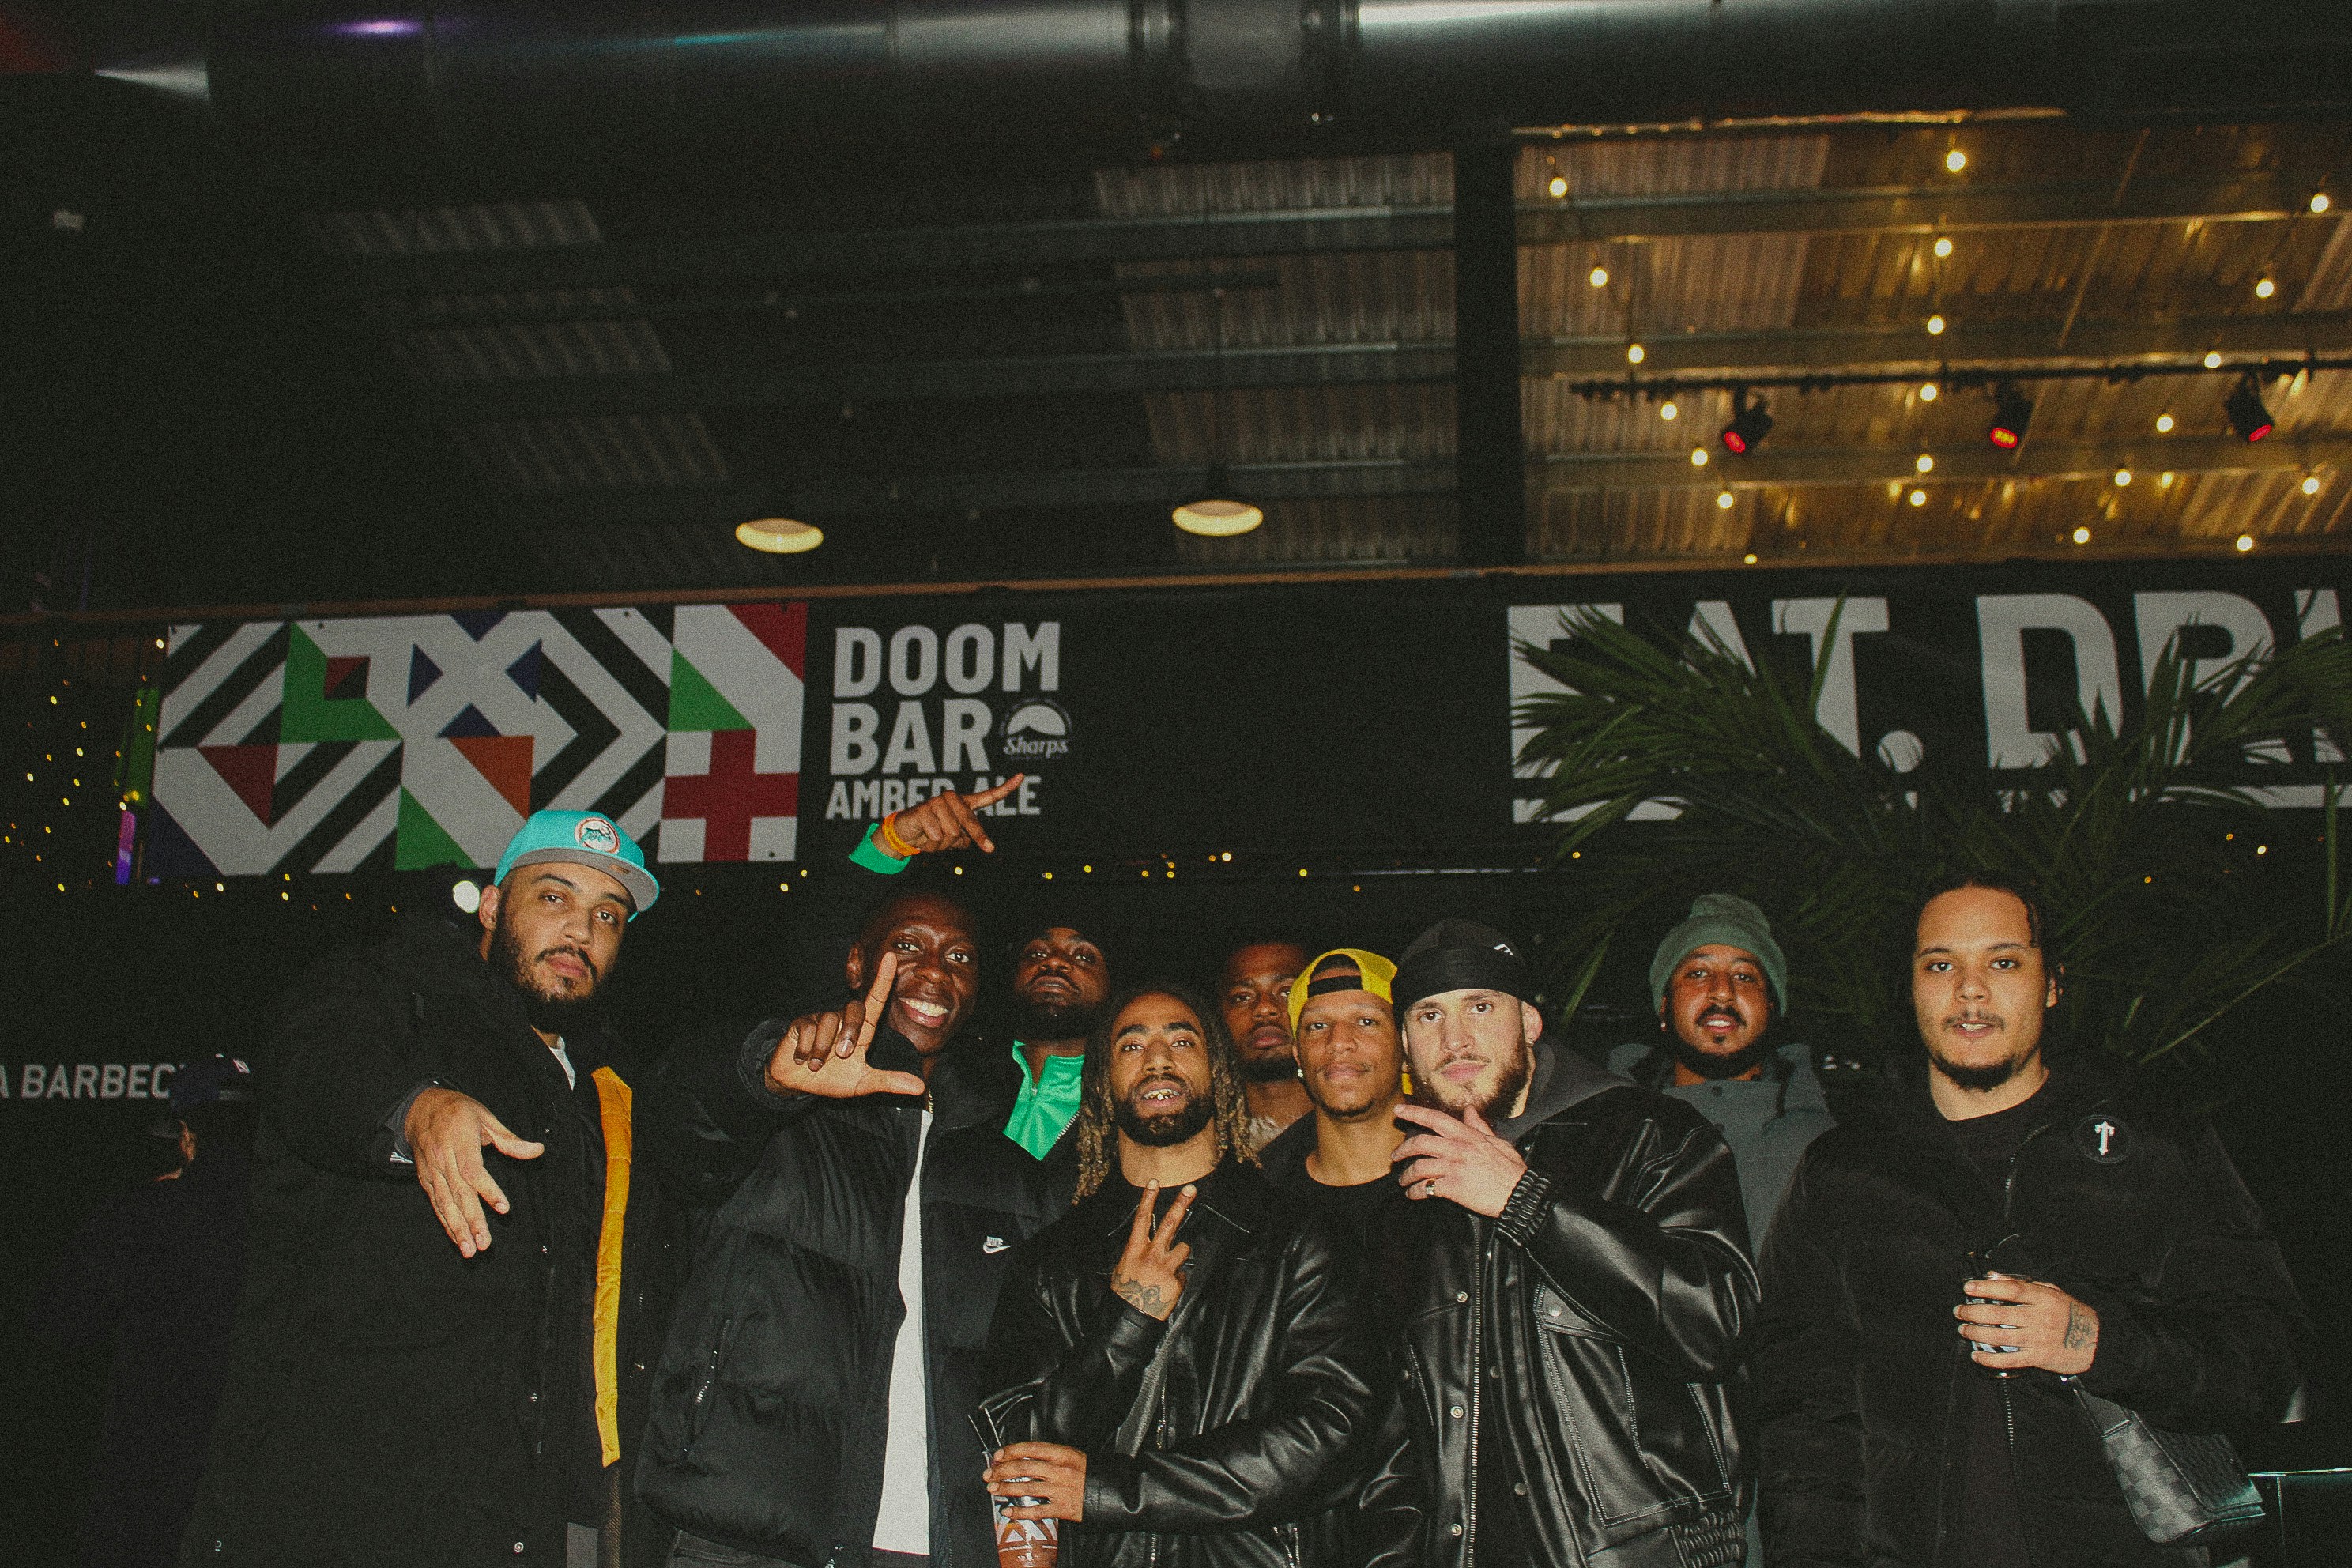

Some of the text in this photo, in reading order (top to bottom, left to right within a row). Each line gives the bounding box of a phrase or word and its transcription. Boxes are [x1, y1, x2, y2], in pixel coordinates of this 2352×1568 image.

[833, 621, 1061, 698] DOOM
[1507, 597, 1924, 779] ET.
[829, 698, 993, 775] BAR
[21, 1063, 185, 1099] BARBEC
